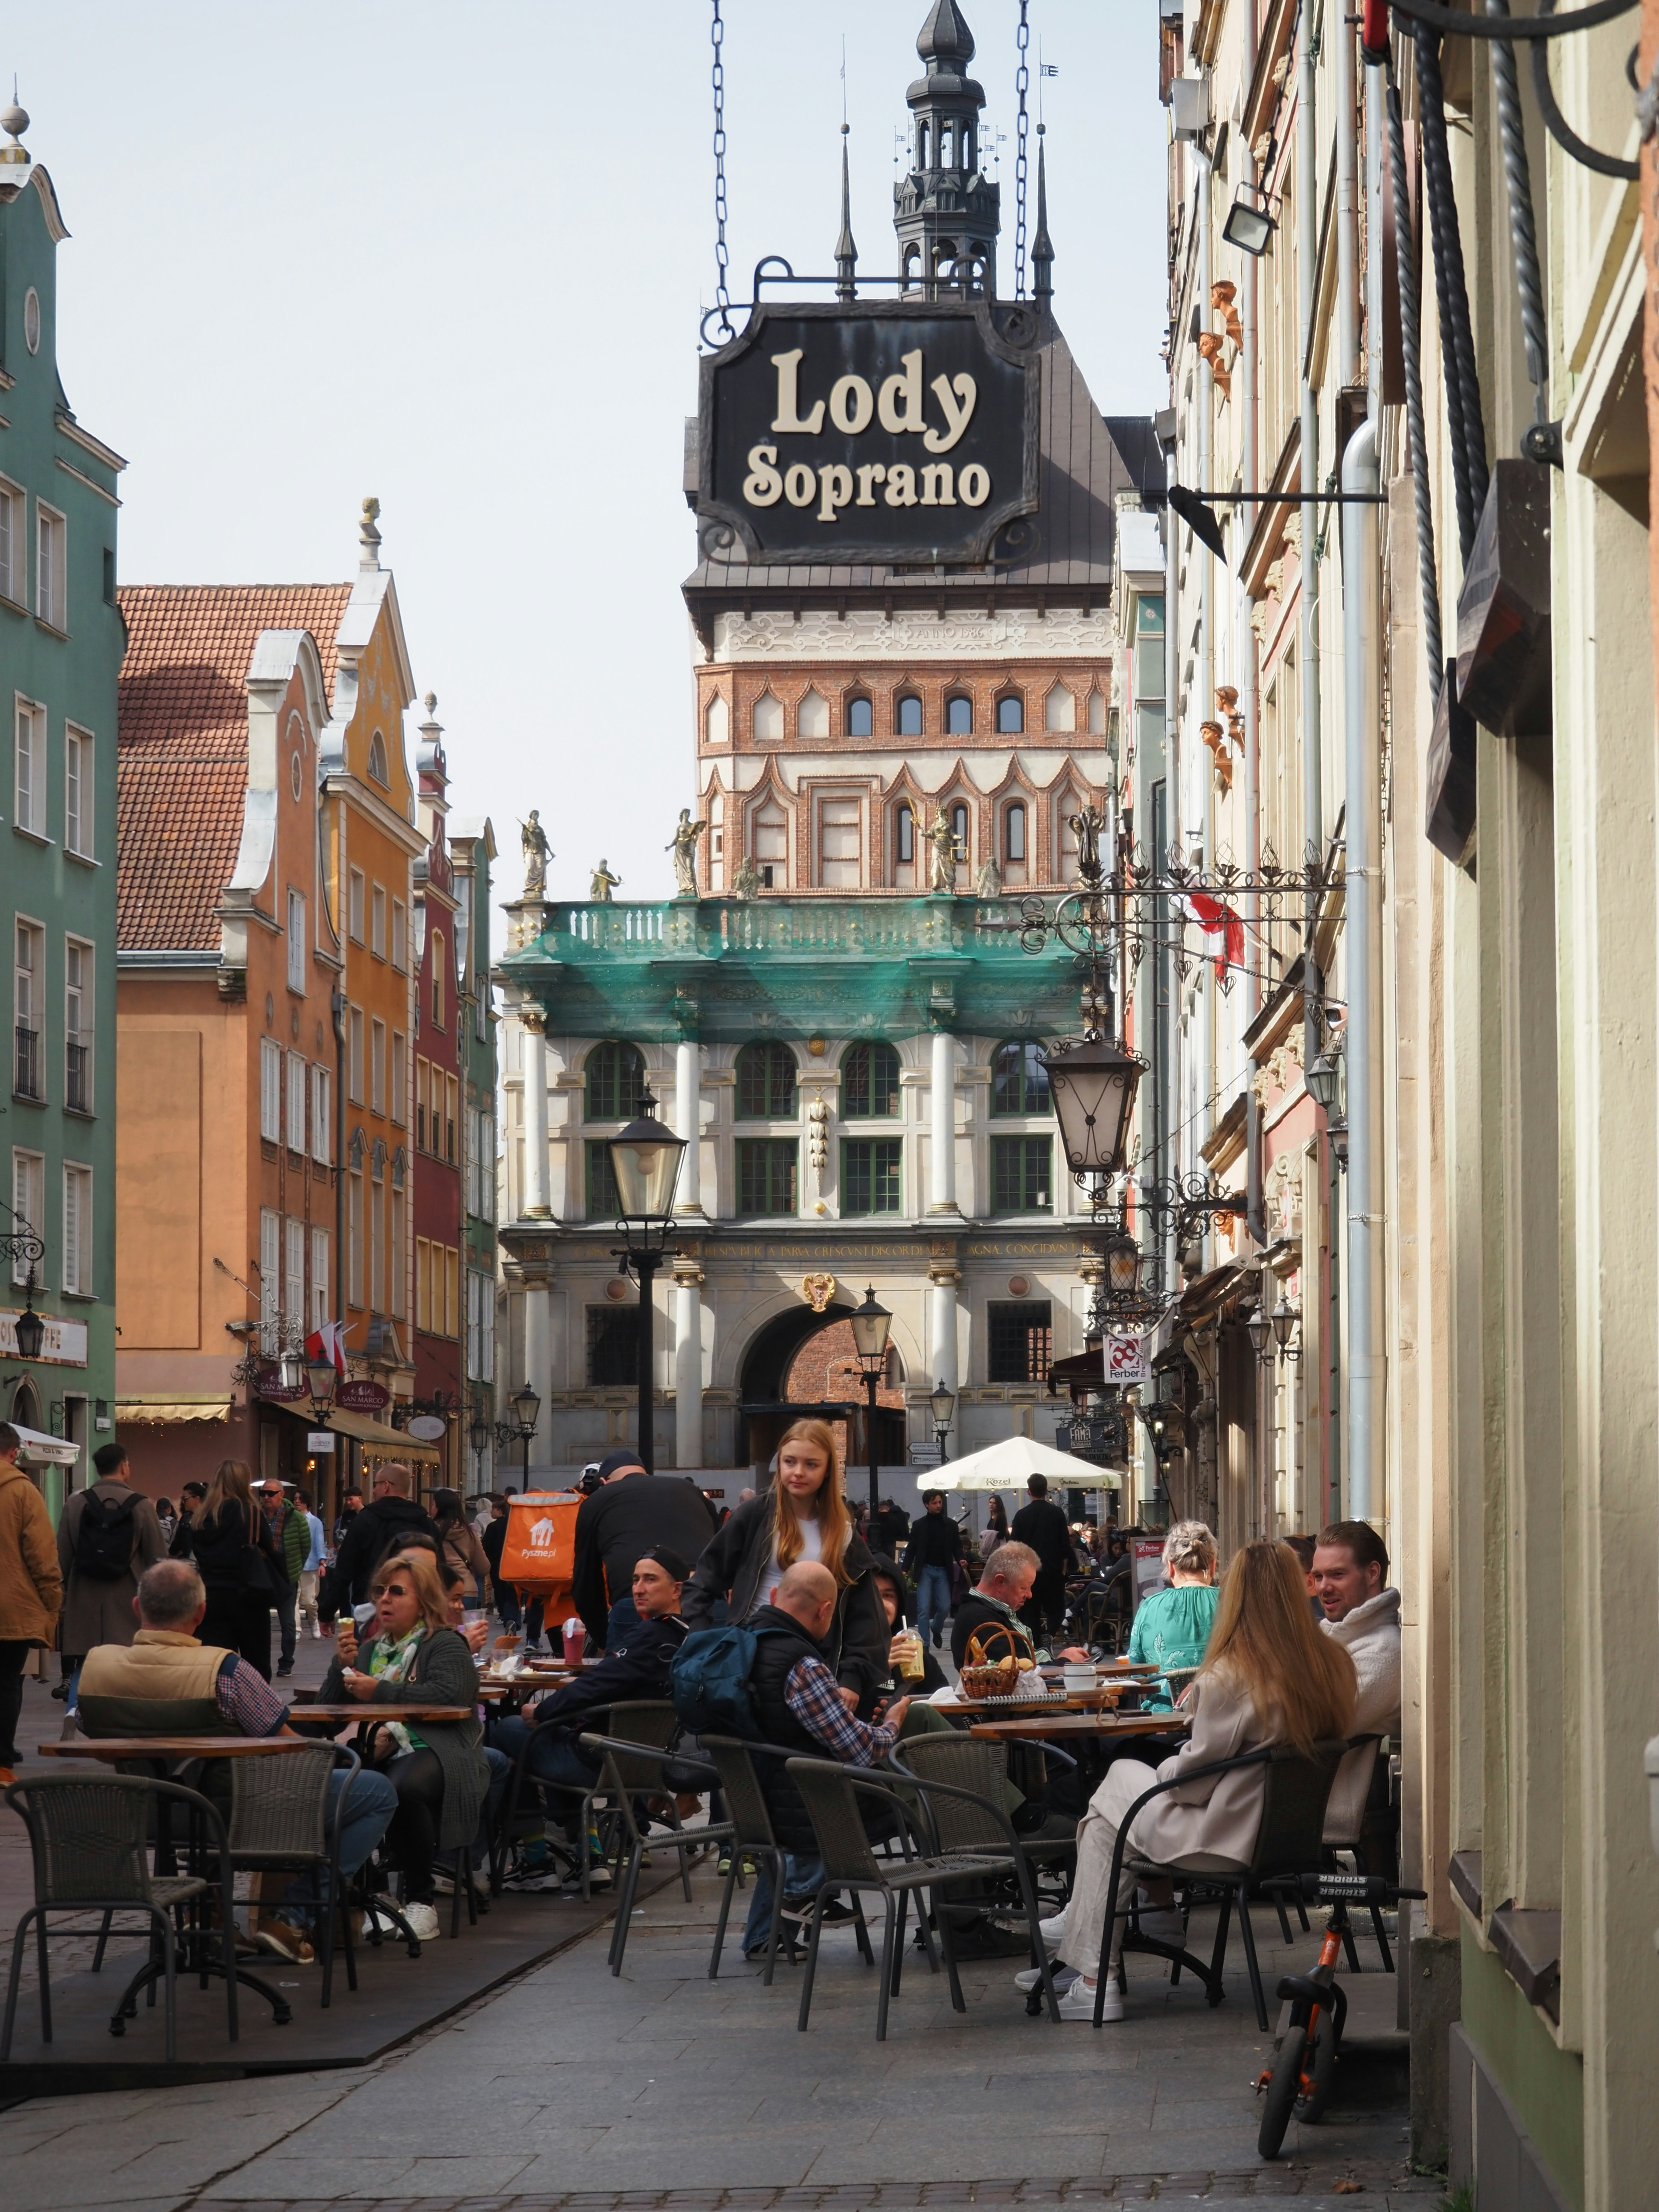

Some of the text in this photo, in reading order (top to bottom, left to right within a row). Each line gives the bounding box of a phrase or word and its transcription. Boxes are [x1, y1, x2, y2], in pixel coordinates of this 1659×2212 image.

[771, 349, 977, 454] Lody
[743, 445, 990, 521] Soprano
[916, 627, 984, 638] ANNO 1586
[1110, 1369, 1140, 1378] Ferber
[1070, 1428, 1091, 1441] FAMA
[986, 1478, 1011, 1486] Kozel
[521, 1549, 556, 1559] Pyszne.pl
[1318, 1874, 1367, 1884] STRIDER
[1319, 1887, 1367, 1897] STRIDER
